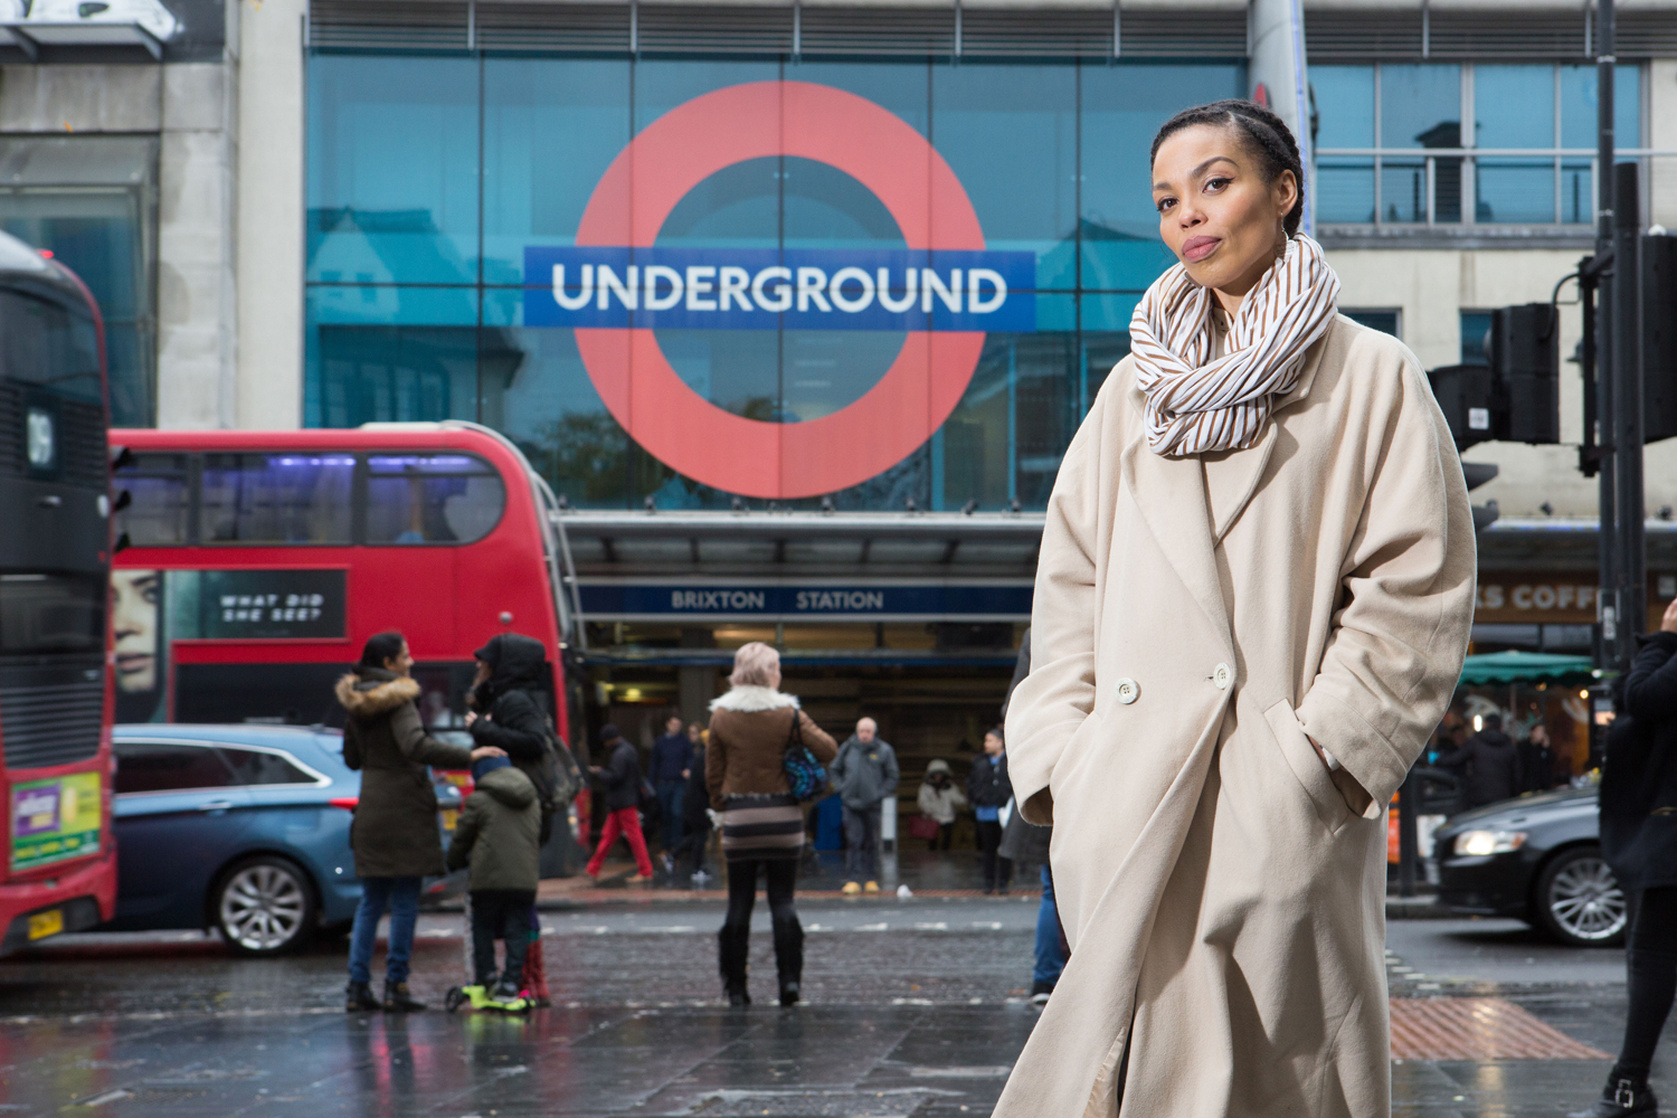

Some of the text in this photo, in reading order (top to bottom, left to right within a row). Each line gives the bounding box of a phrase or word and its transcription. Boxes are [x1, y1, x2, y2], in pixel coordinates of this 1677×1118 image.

[552, 264, 1007, 313] UNDERGROUND
[220, 593, 324, 608] WHAT DID
[671, 591, 883, 609] BRIXTON STATION
[223, 608, 321, 622] SHE SEE?
